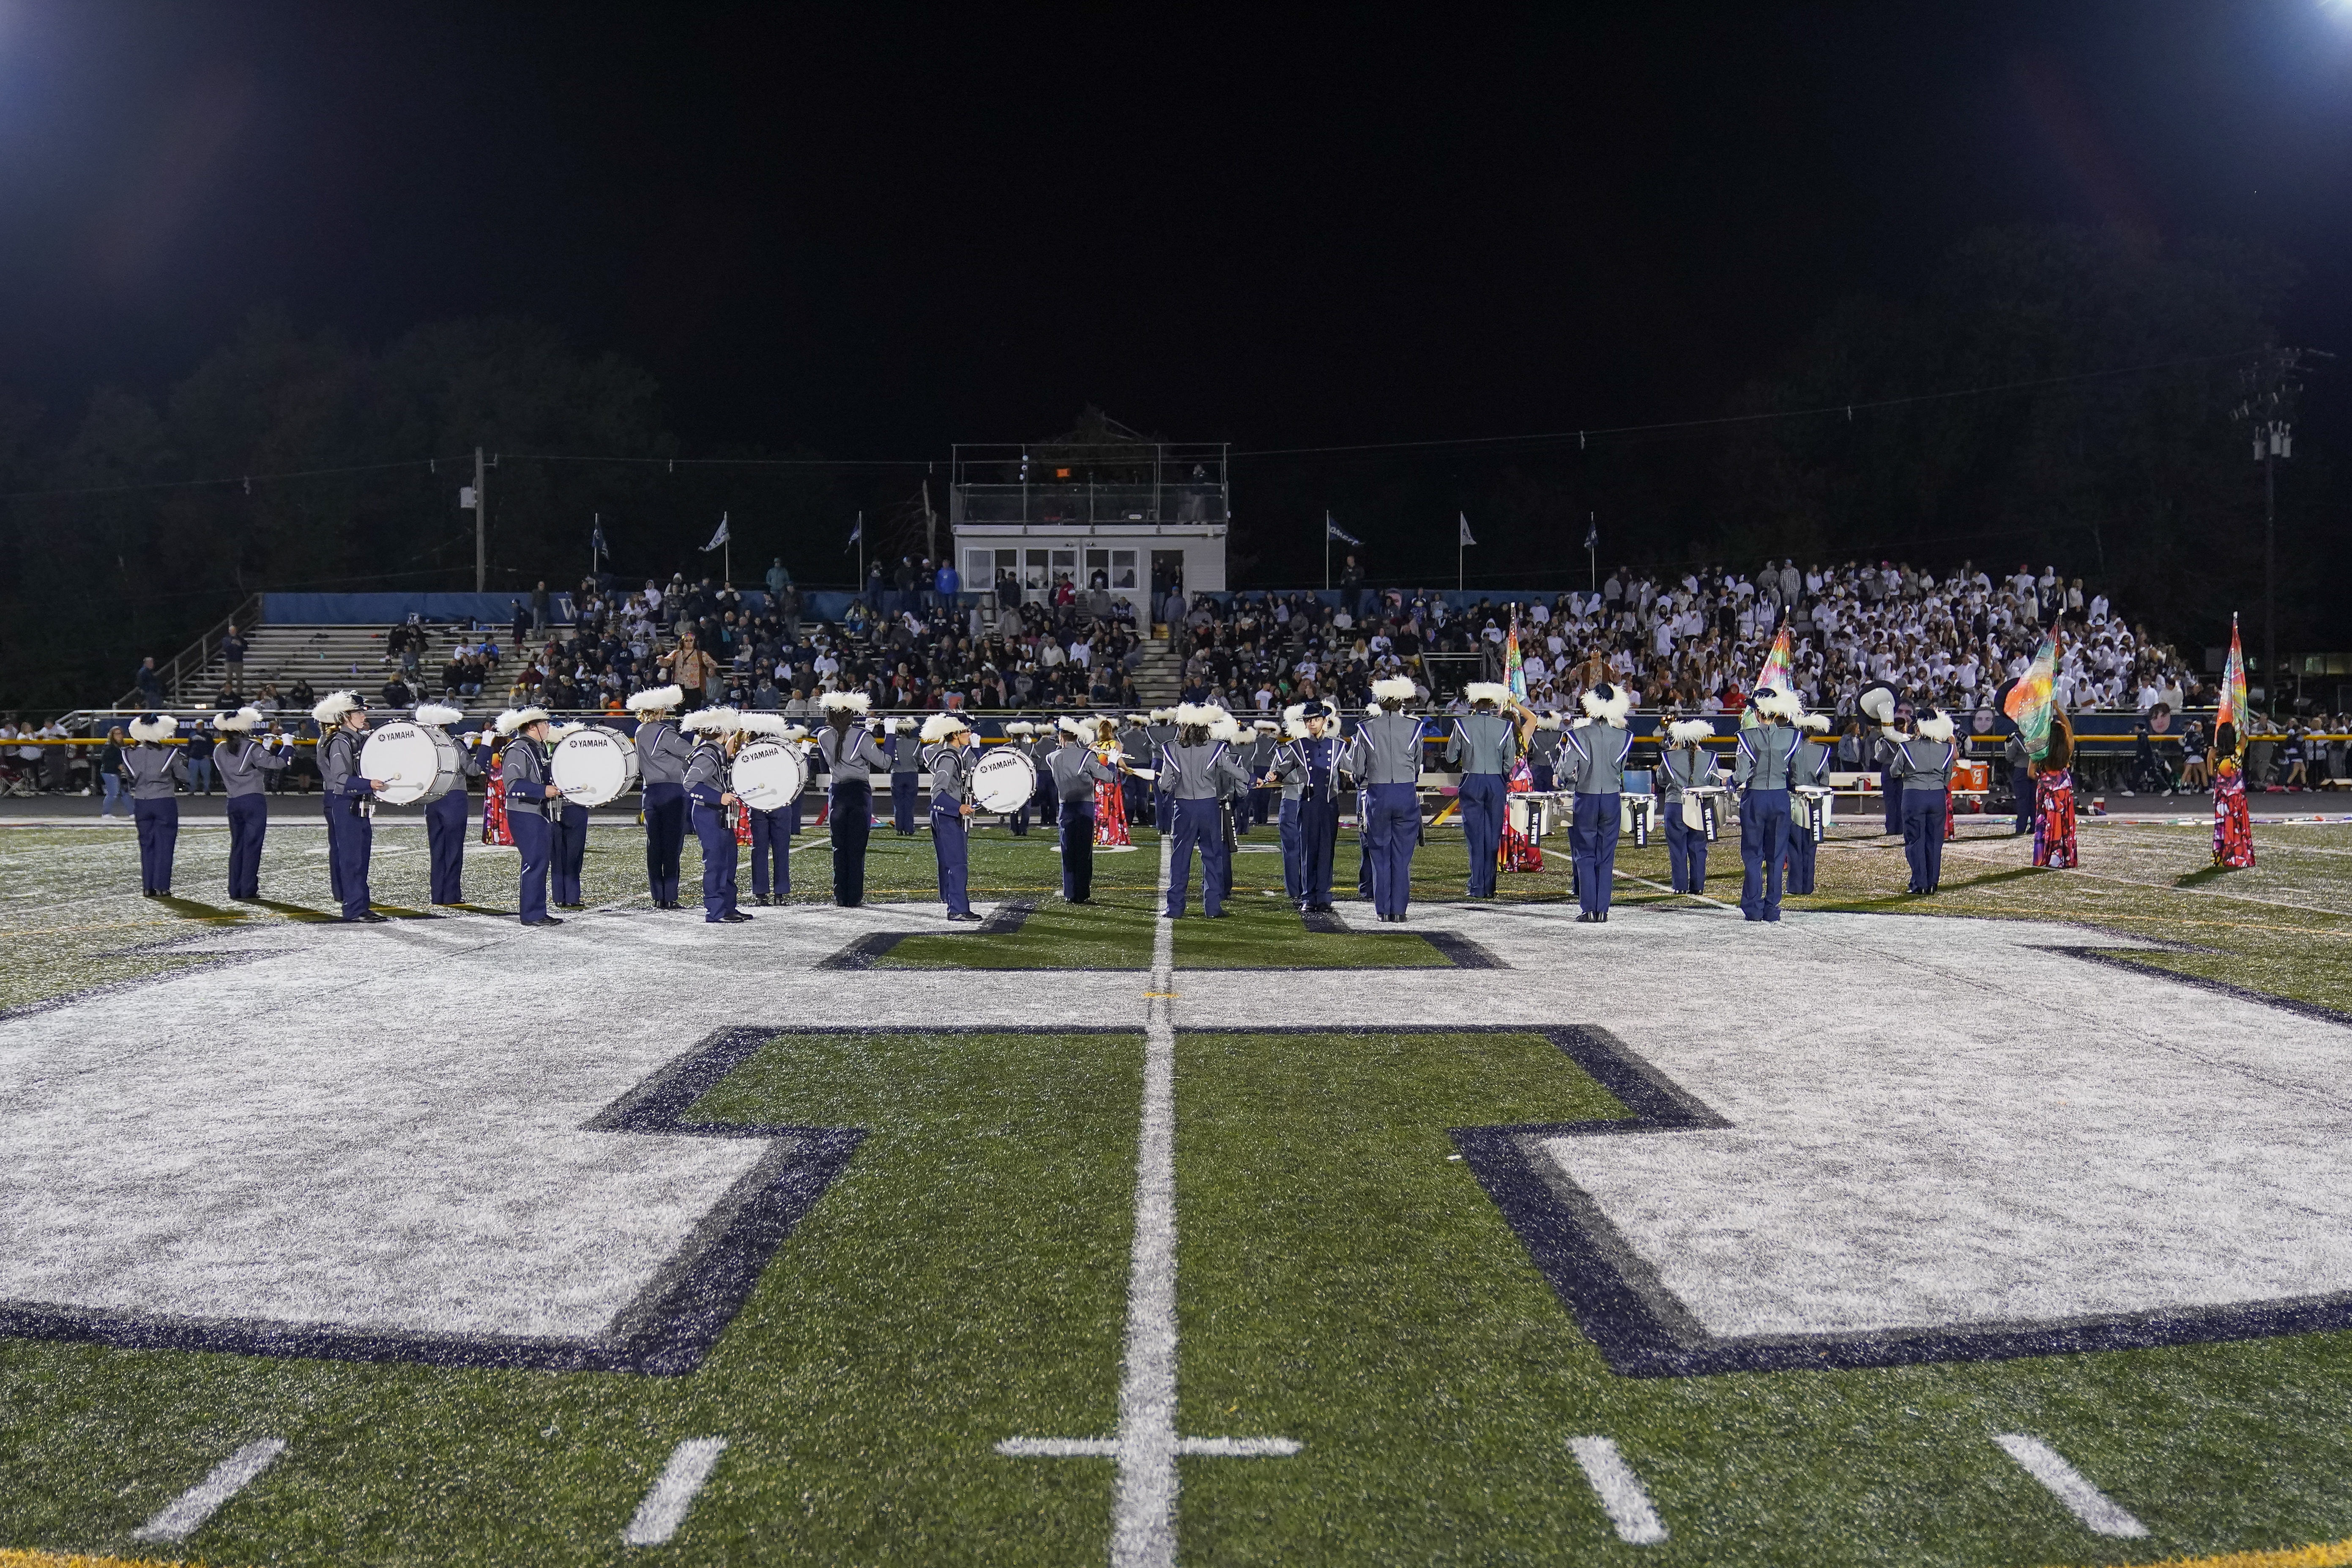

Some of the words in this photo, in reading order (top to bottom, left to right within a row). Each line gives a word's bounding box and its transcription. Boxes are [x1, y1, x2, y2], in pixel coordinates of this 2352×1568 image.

[386, 730, 415, 741] YAMAHA
[578, 739, 608, 747] YAMAHA
[749, 747, 779, 761] YAMAHA
[988, 758, 1017, 771] YAMAHA
